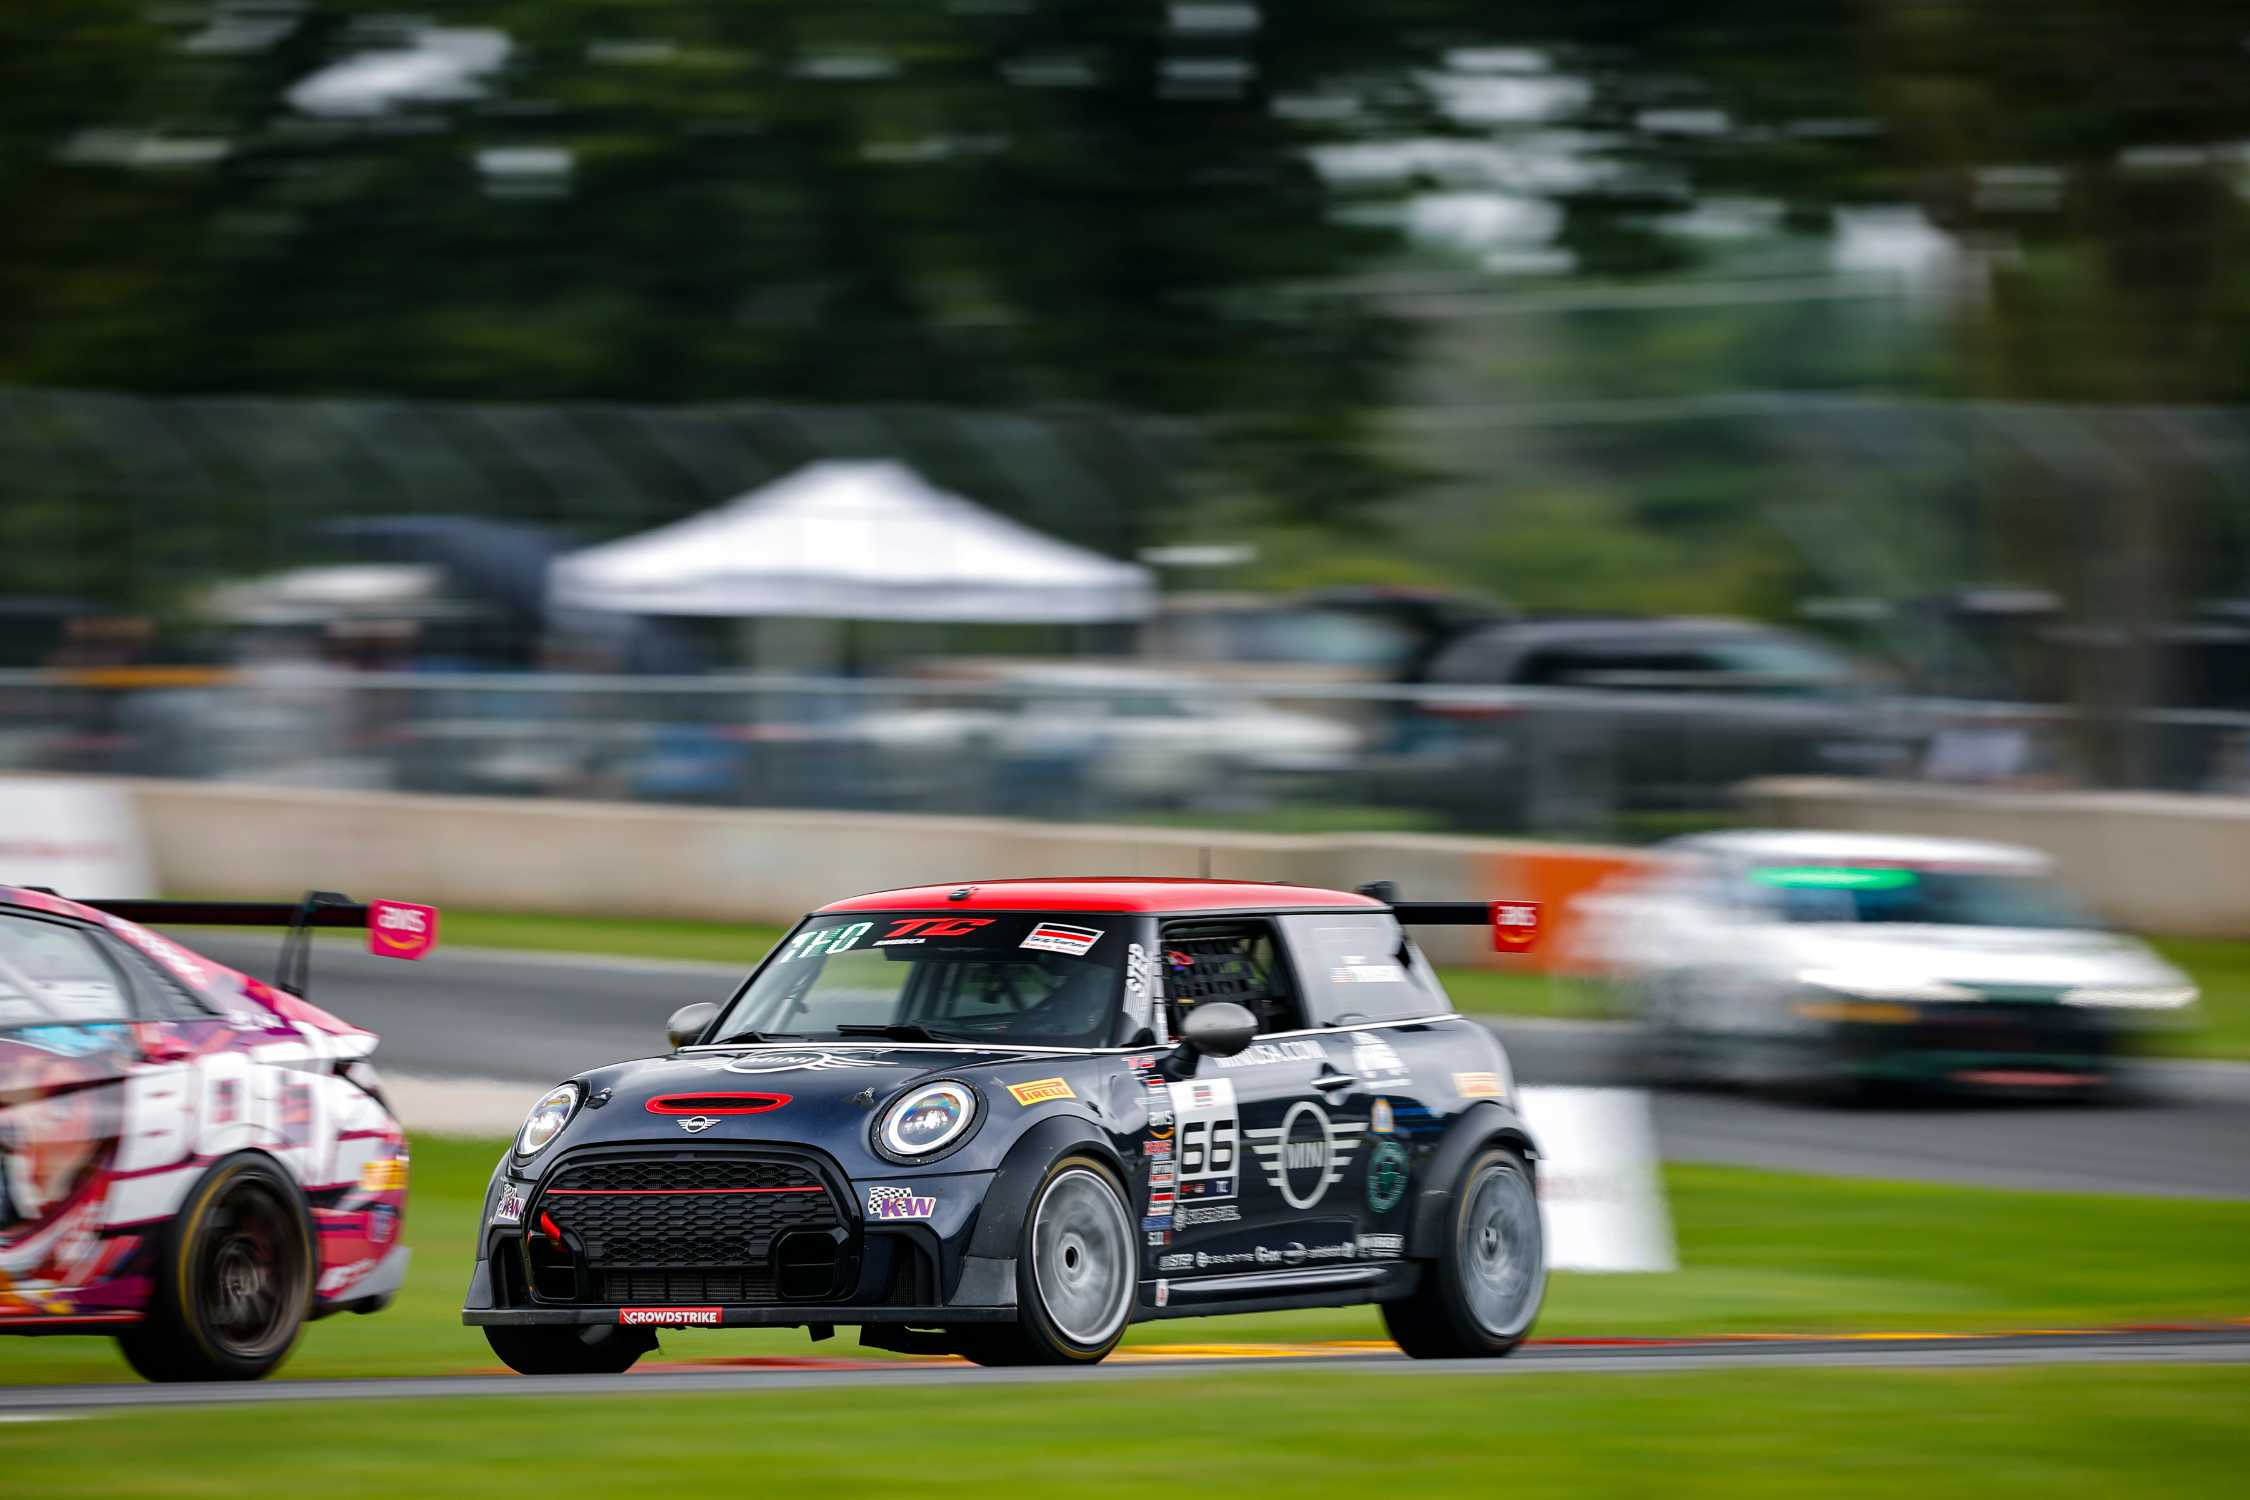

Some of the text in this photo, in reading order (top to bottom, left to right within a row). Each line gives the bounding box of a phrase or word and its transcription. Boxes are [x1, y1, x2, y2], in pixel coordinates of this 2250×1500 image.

[884, 917, 997, 938] TC
[1013, 1080, 1071, 1101] PIRELLI
[1181, 1120, 1235, 1174] 66
[881, 1196, 933, 1218] KW
[629, 1311, 718, 1324] CROWDSTRIKE
